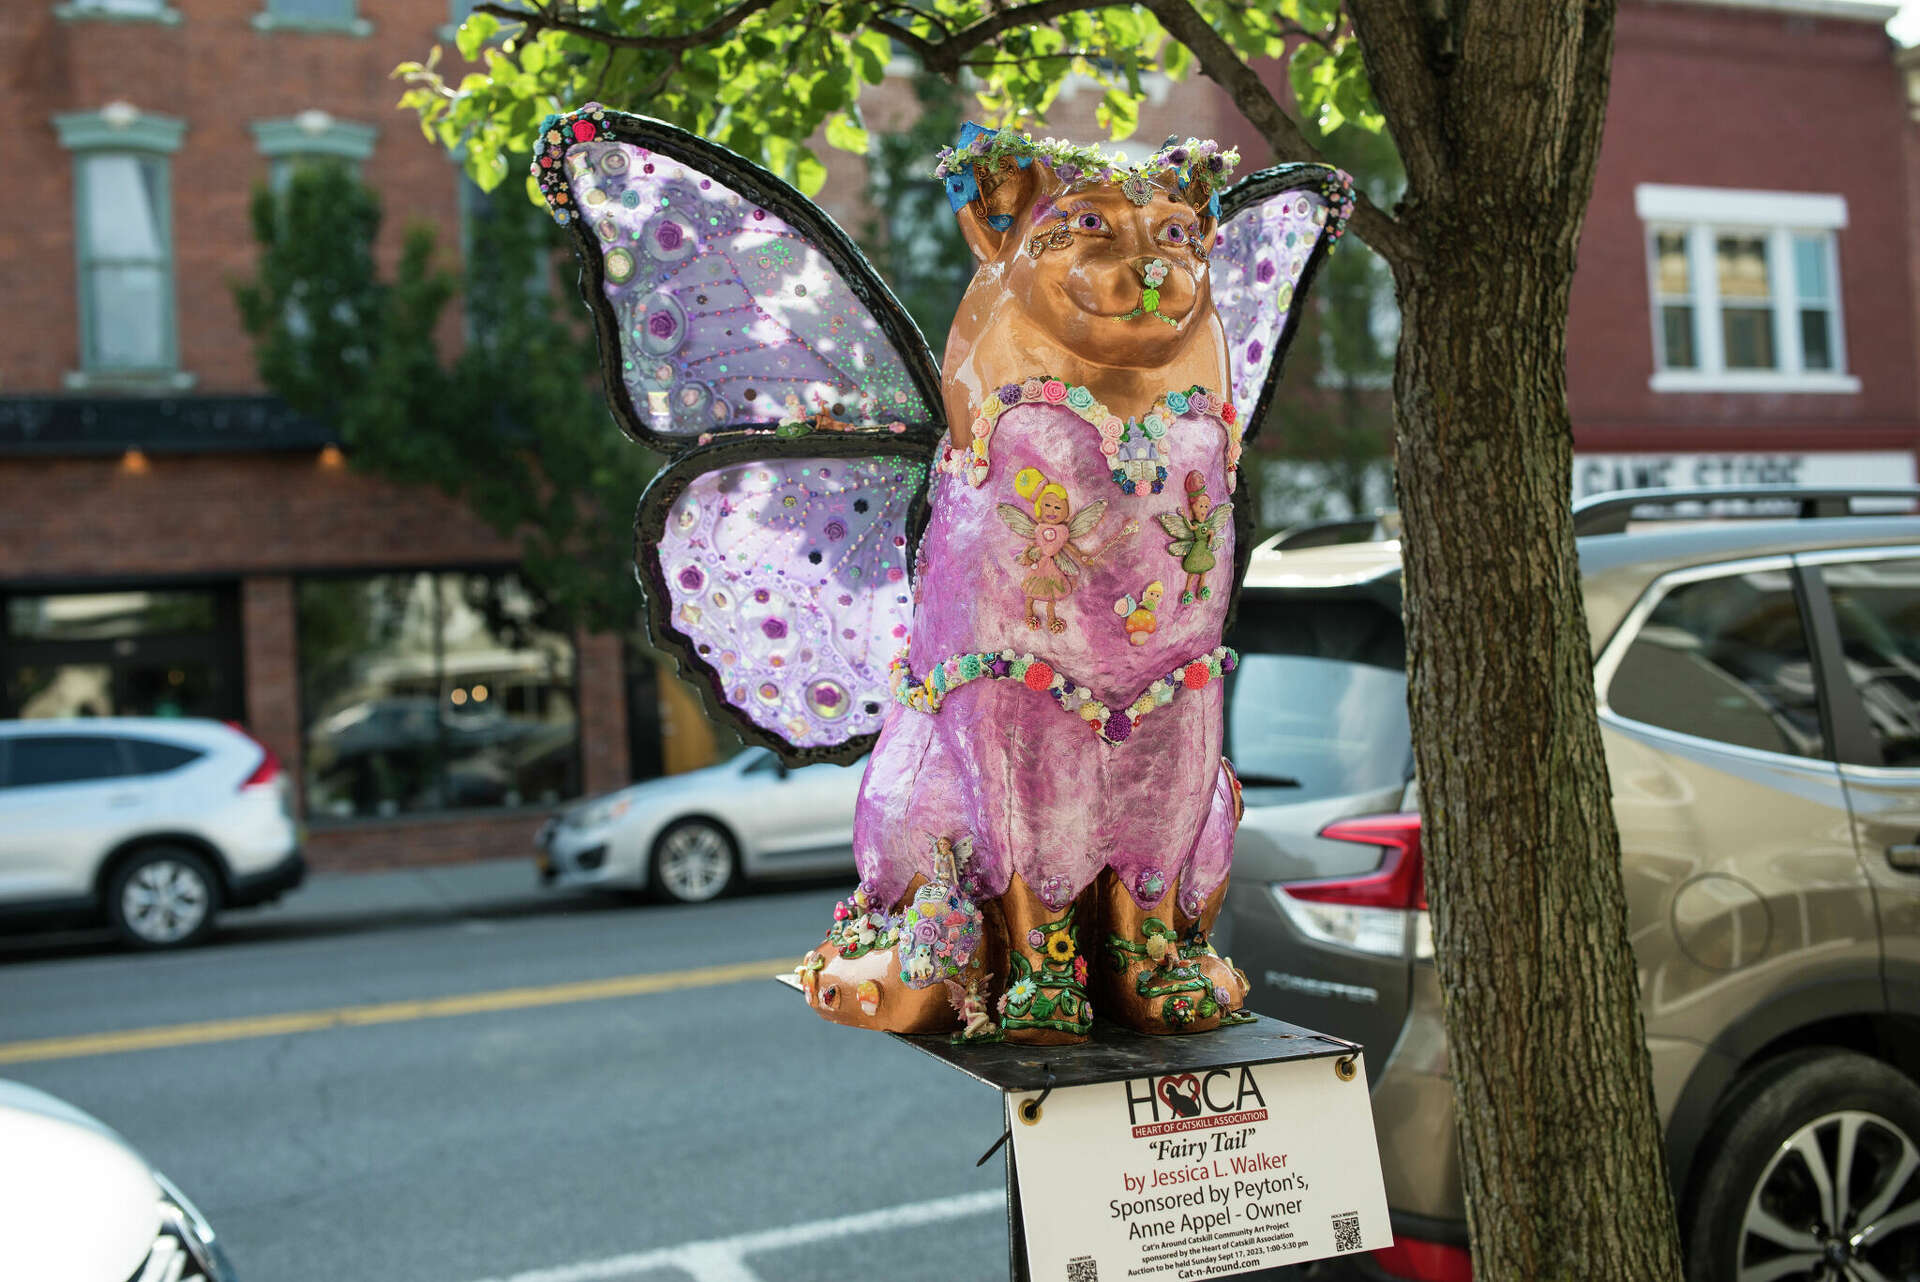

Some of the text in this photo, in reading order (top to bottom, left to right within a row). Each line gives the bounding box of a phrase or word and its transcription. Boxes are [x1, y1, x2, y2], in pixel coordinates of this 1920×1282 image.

[1135, 1111, 1266, 1137] HEART OF CATSKILL ASSOCIATION
[1149, 1127, 1256, 1163] “Fairy Tail”
[1123, 1152, 1288, 1195] by Jessica L. Walker
[1110, 1172, 1309, 1221] Sponsored by Peyton's,
[1129, 1219, 1175, 1240] Anne
[1180, 1206, 1231, 1235] Appel
[1245, 1199, 1303, 1221] Owner
[1142, 1221, 1289, 1252] Cat'n Around Catskill Community Art Project
[1128, 1267, 1155, 1277] Auction
[1175, 1260, 1190, 1268] held
[1191, 1255, 1217, 1266] Sunday
[1218, 1252, 1234, 1261] Sept
[1235, 1250, 1246, 1258] 17,
[1247, 1247, 1265, 1256] 2023,
[1266, 1242, 1297, 1252] 1:00-5:30
[1297, 1240, 1309, 1249] pm
[1142, 1250, 1179, 1264] sponsored
[1179, 1249, 1188, 1258] by
[1189, 1247, 1201, 1255] the
[1202, 1243, 1221, 1253] Heart
[1230, 1237, 1255, 1247] Catskill
[1256, 1231, 1294, 1244] Association
[1178, 1258, 1260, 1279] Cat-n-Around.com
